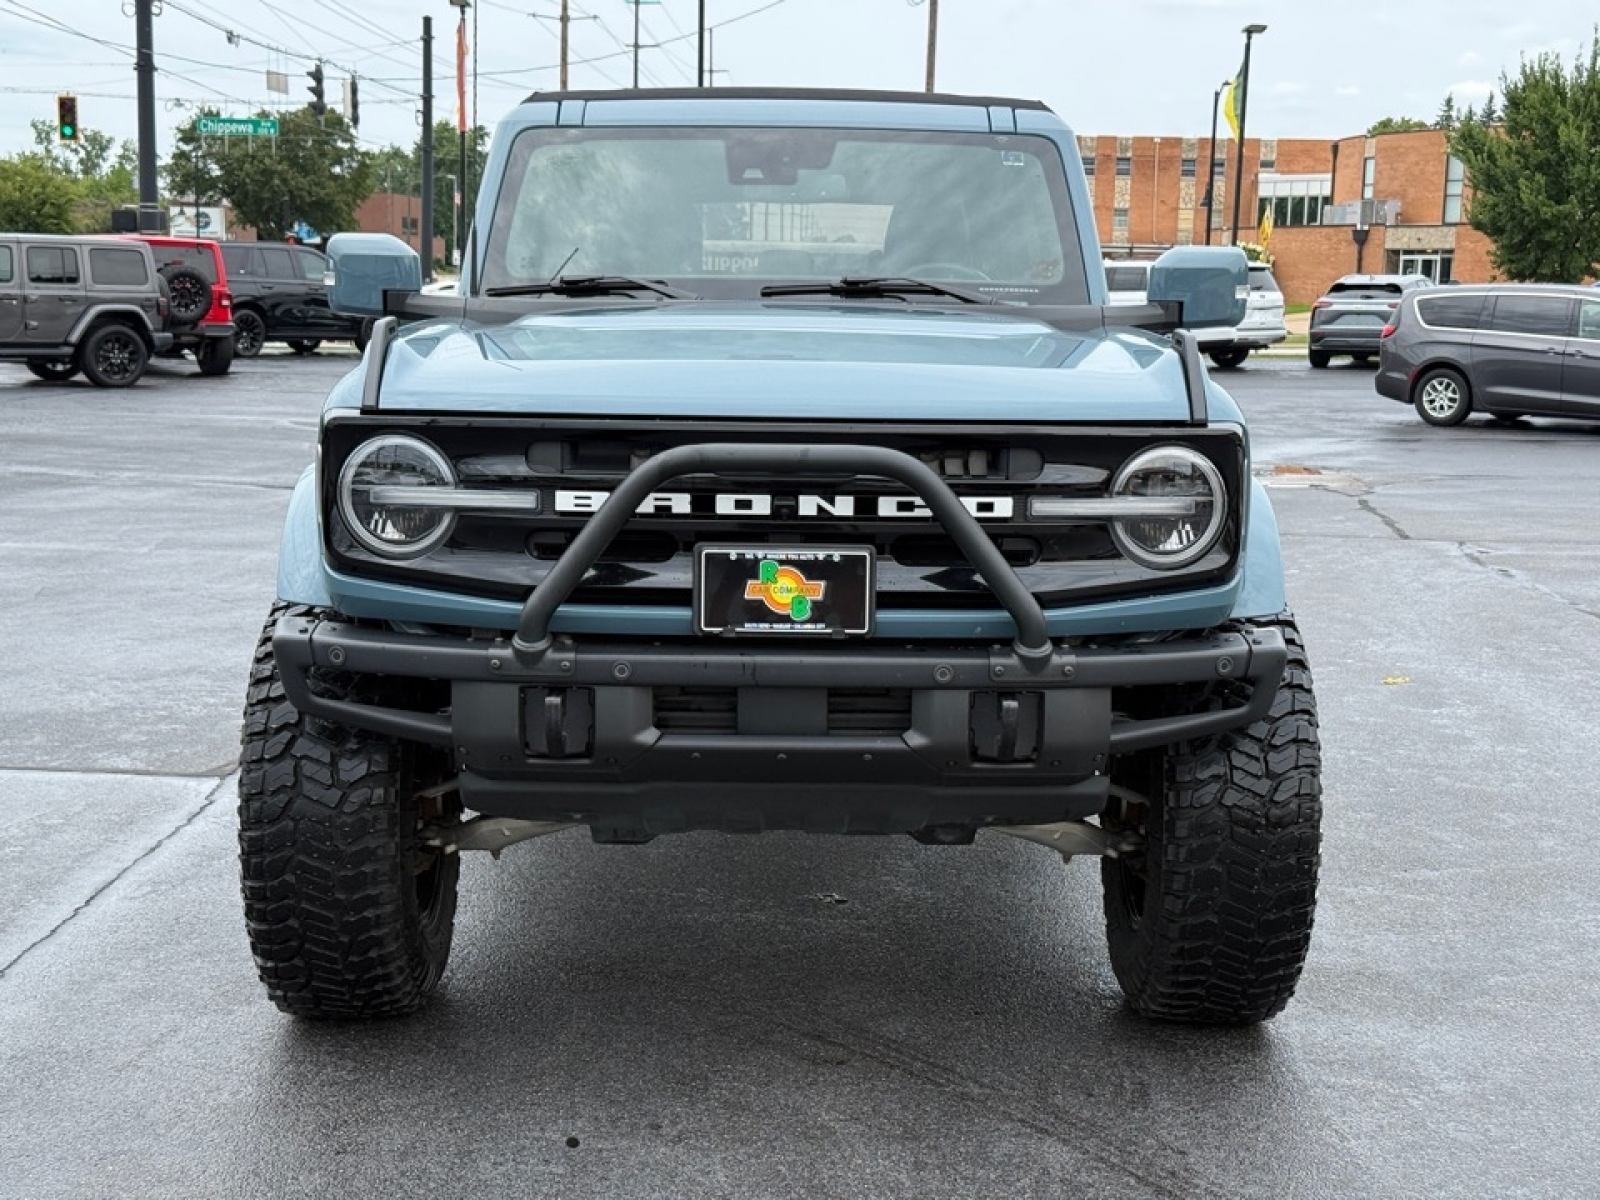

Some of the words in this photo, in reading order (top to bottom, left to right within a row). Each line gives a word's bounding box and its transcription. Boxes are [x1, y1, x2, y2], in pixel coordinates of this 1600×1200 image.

[200, 119, 254, 135] Chippewa
[555, 490, 1014, 518] BRONCO
[760, 559, 779, 584] R
[751, 586, 771, 594] CAR
[773, 586, 818, 594] COMPANY
[790, 595, 811, 621] B
